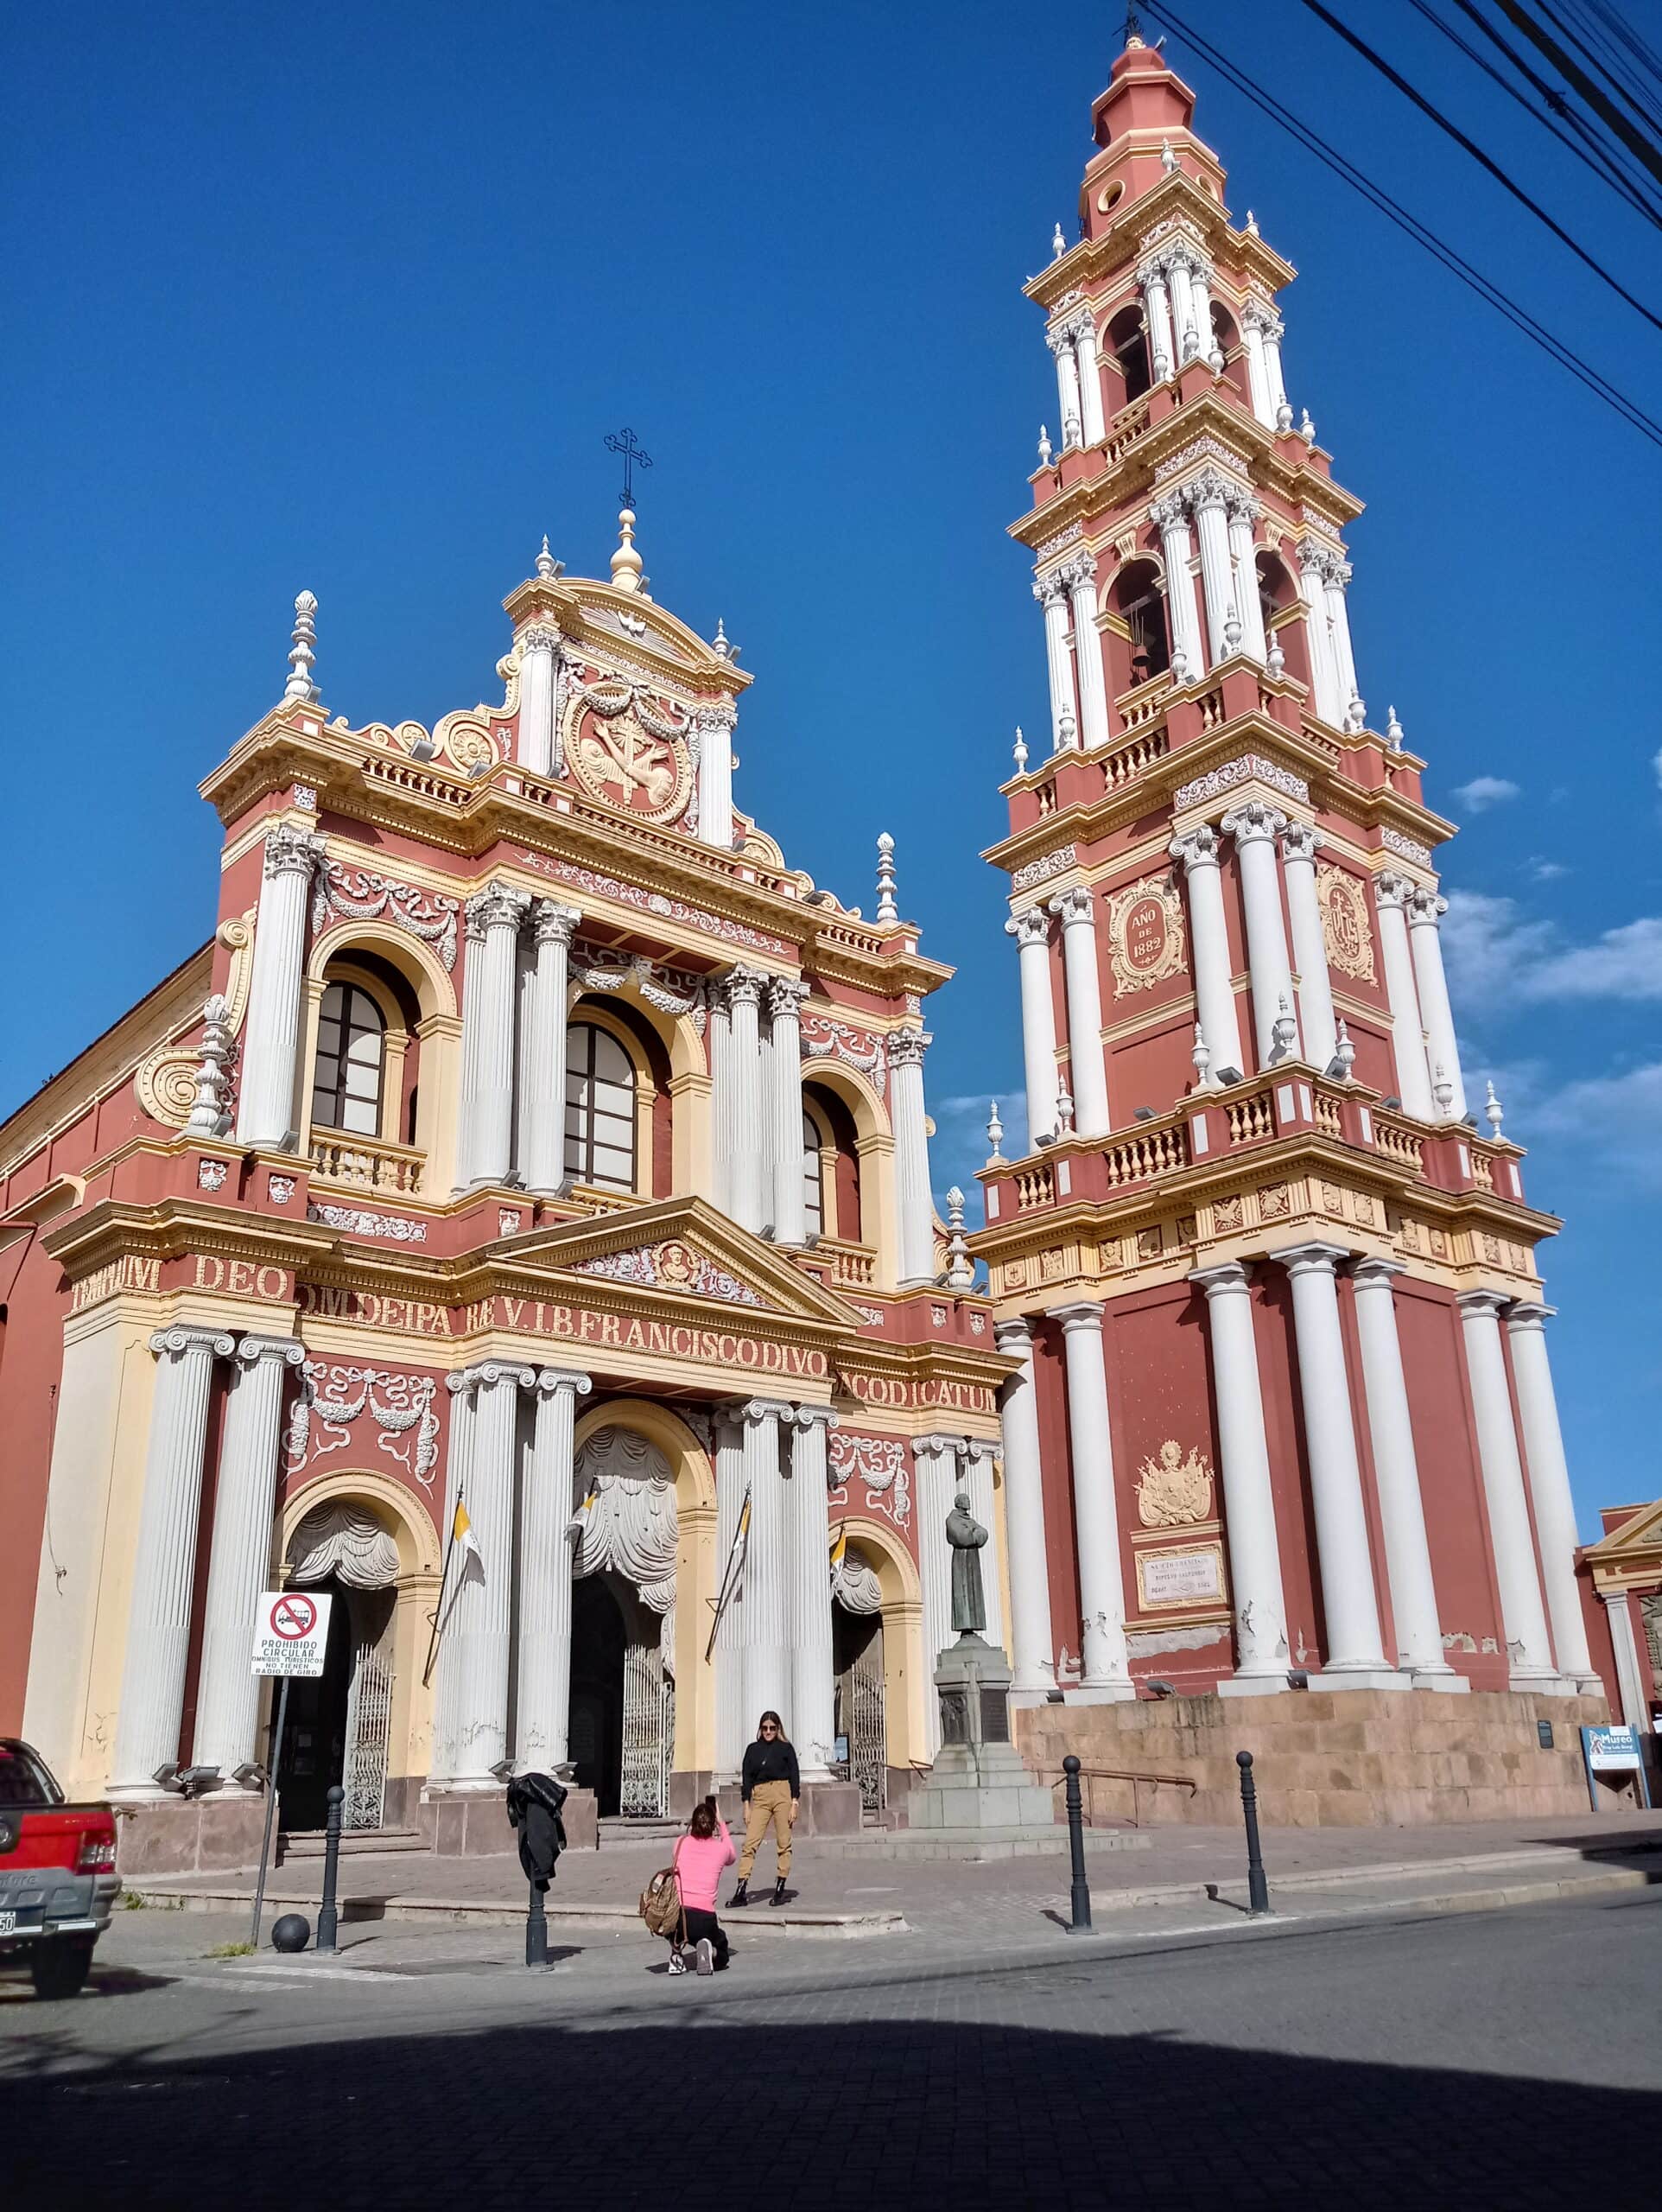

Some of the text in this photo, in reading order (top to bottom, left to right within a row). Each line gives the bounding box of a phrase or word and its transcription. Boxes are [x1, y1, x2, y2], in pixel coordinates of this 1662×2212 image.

[1132, 905, 1156, 930] AÑO
[1139, 927, 1152, 939] DE
[1133, 937, 1161, 958] 1882
[192, 1255, 289, 1300] DEO
[760, 1340, 828, 1376] DIVO
[262, 1640, 317, 1649] PROHIBIDO
[263, 1649, 314, 1657] CIRCULAR
[1602, 1734, 1633, 1744] Museo
